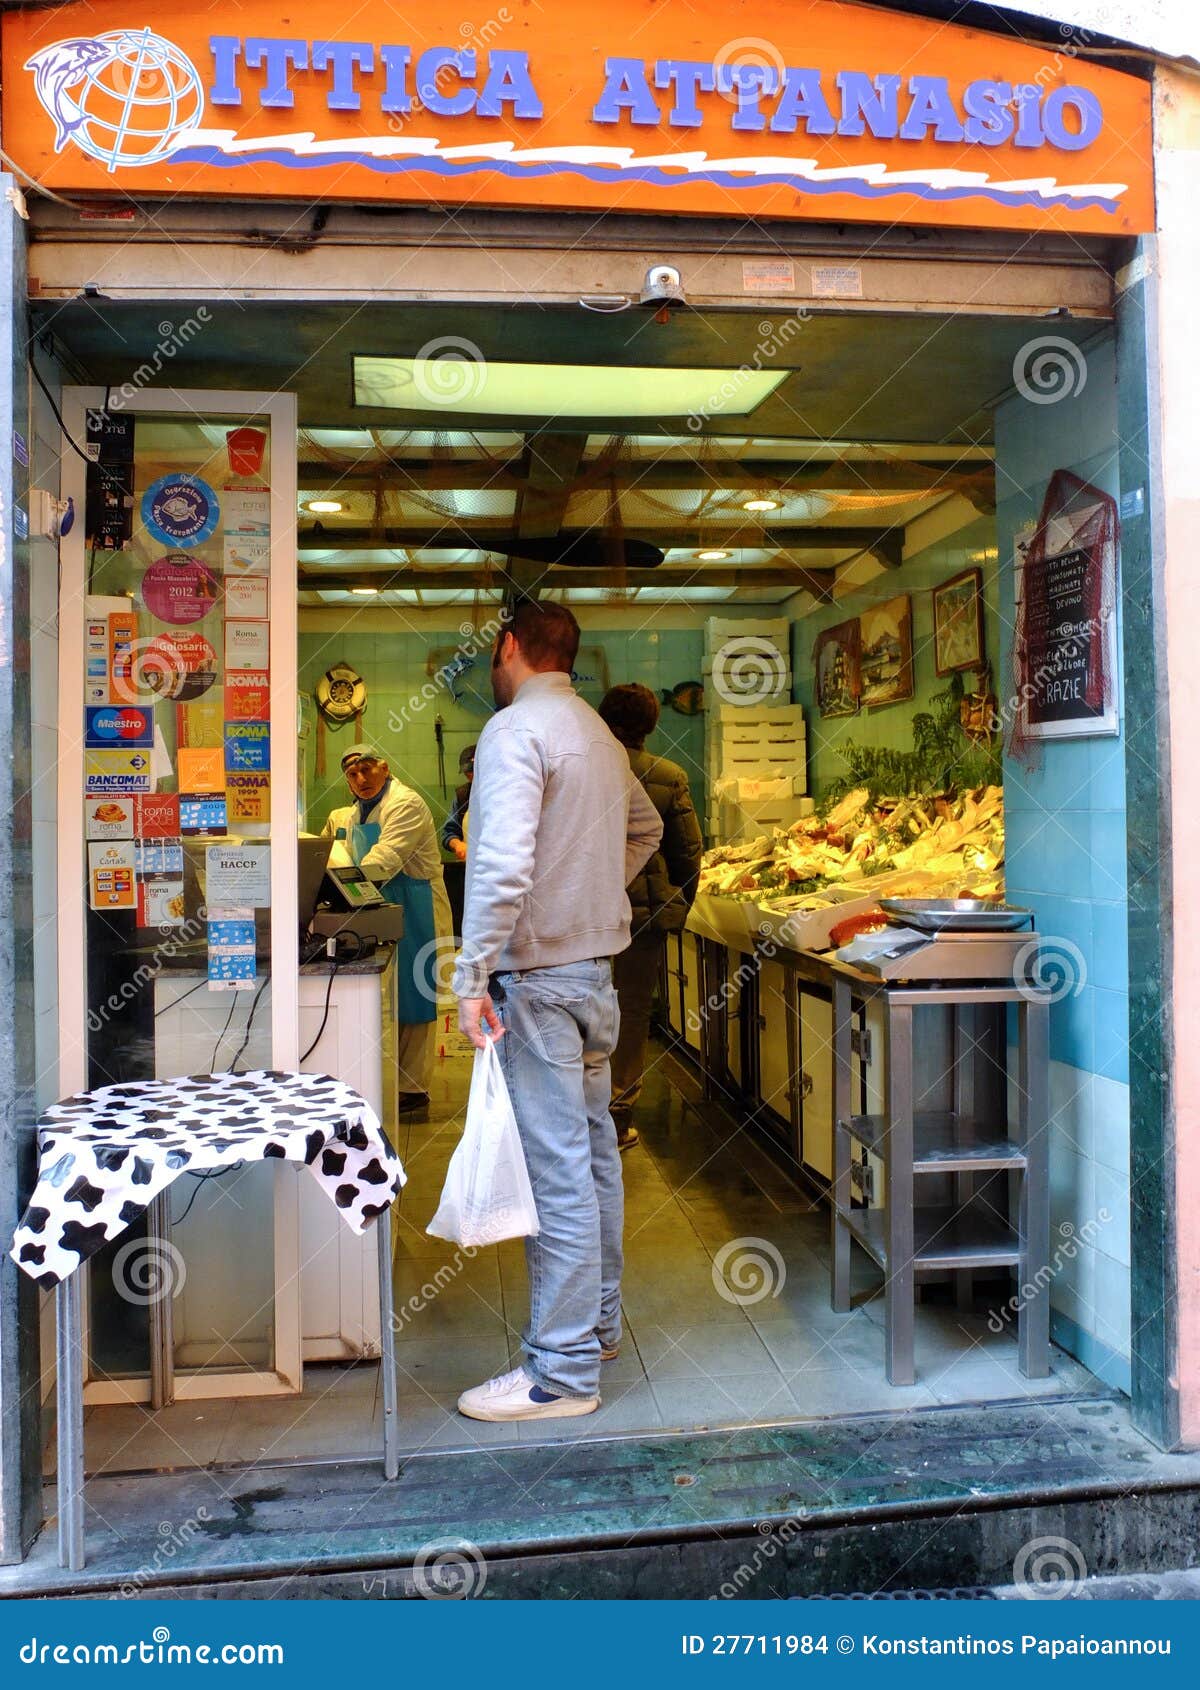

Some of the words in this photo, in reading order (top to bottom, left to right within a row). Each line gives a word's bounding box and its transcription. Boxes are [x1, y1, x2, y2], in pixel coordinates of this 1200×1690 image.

[209, 35, 544, 120] ITTICA
[593, 56, 1104, 152] ATTANASIO
[168, 586, 193, 598] 2012
[226, 675, 269, 688] ROMA
[97, 719, 142, 729] Maestro
[226, 725, 269, 738] ROMA
[88, 775, 148, 785] BANCOMAT
[226, 776, 269, 788] ROMA
[144, 806, 174, 817] roma
[220, 860, 257, 869] HACCP
